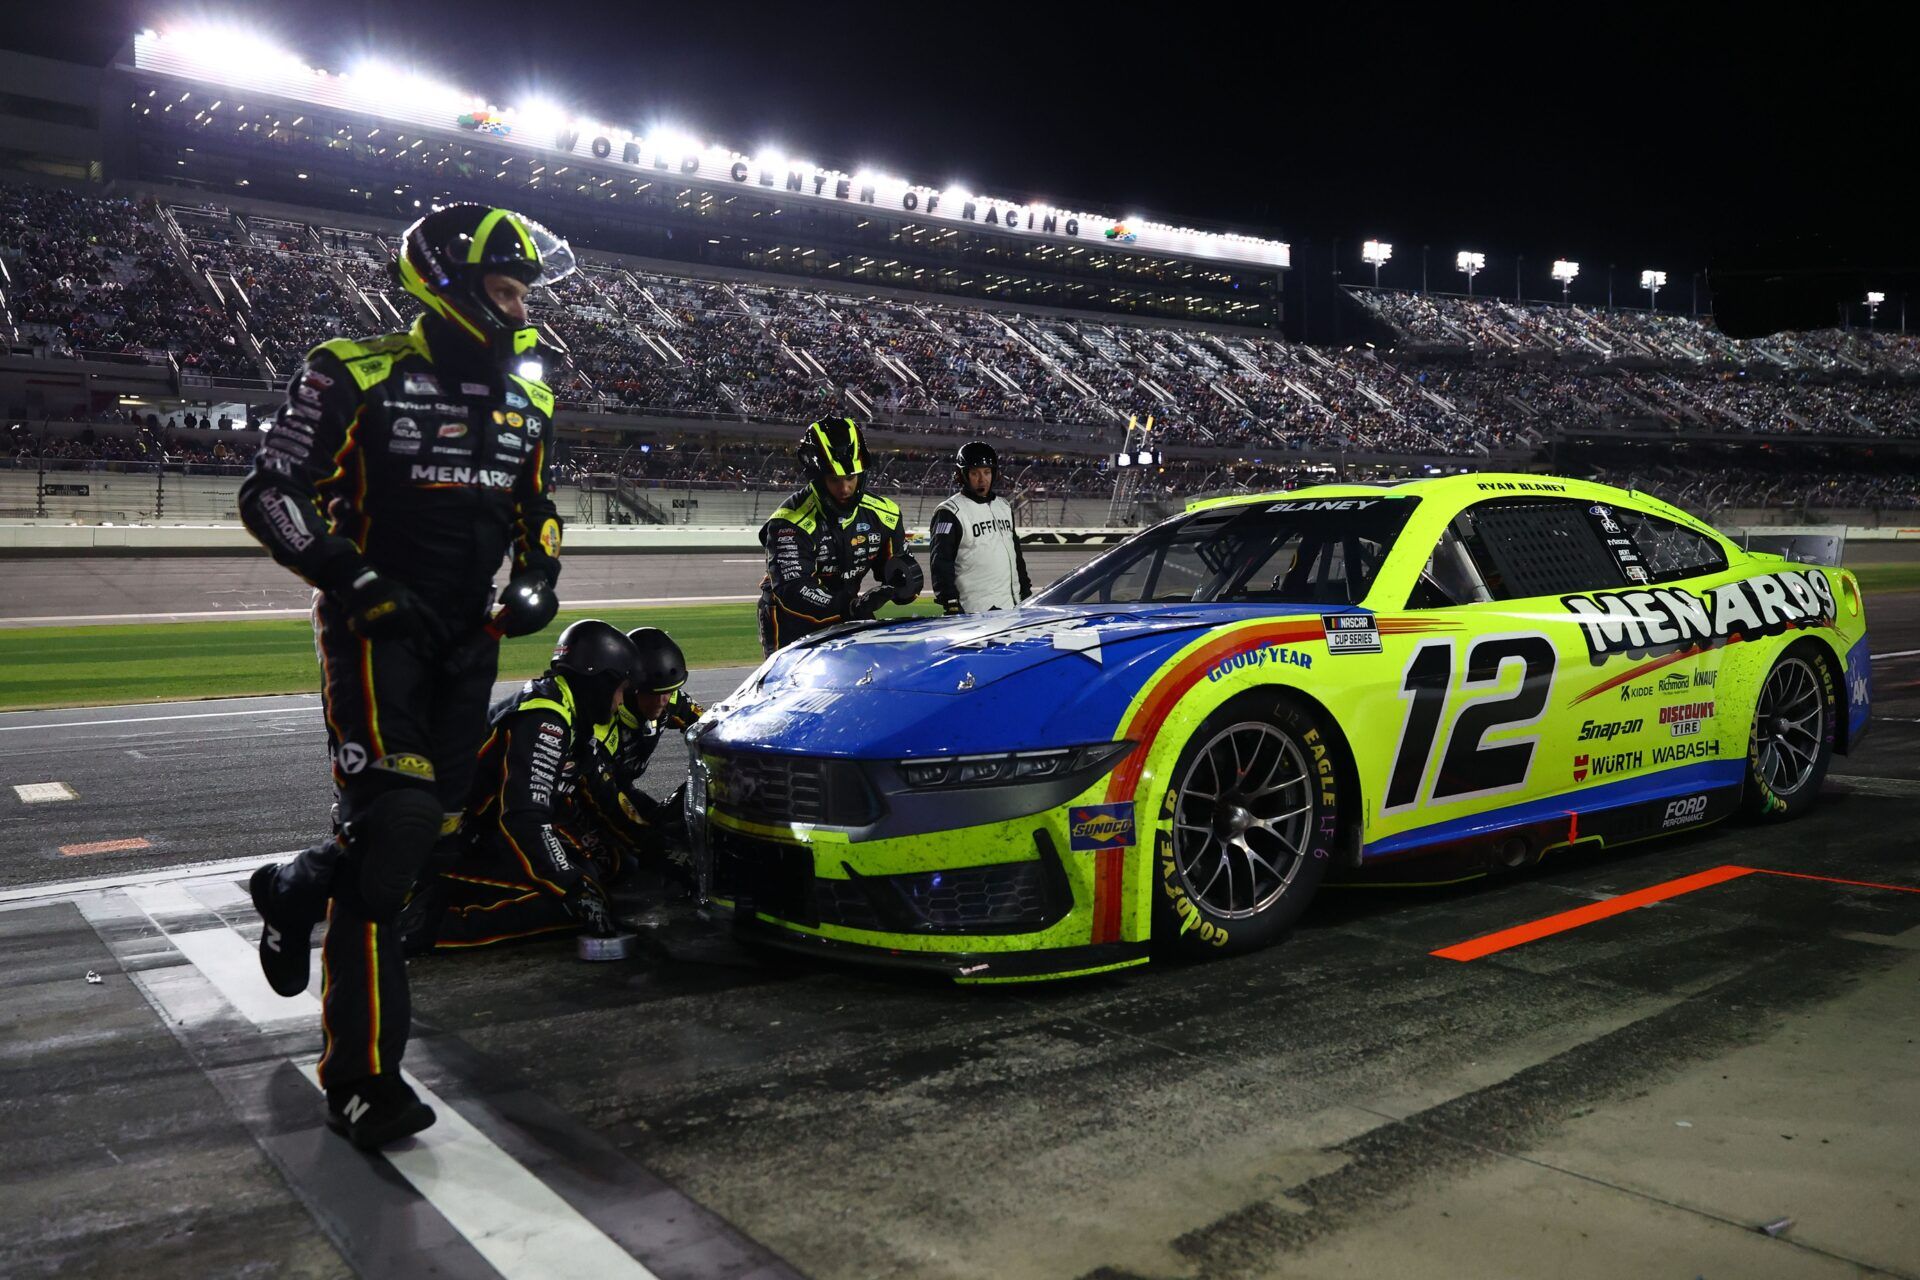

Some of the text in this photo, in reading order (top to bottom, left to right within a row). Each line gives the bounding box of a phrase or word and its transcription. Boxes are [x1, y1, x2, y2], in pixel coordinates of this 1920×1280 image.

[555, 126, 1079, 237] WORLD CENTER OF RACING
[410, 464, 517, 487] MENARDS
[1476, 482, 1566, 492] RYAN BLANEY
[1264, 500, 1379, 513] BLANEY
[972, 519, 1011, 537] OFFICIA
[1567, 569, 1836, 652] MENARDS
[1341, 617, 1368, 629] NASCAR
[1334, 634, 1373, 645] CUP SERIES
[1207, 643, 1312, 682] GOODYEAR
[1658, 675, 1690, 691] Richmond
[1693, 667, 1718, 688] KNAUF
[1814, 654, 1836, 705] EAGLE
[1631, 686, 1654, 698] KIDDE
[1382, 634, 1557, 812] 12
[1658, 701, 1715, 725] DISCOUNT
[1577, 718, 1644, 741] Snap-on
[1673, 721, 1698, 735] TIRE
[1592, 750, 1643, 775] WÜRTH
[1652, 739, 1720, 765] WABASH
[1302, 728, 1336, 808] EAGLE
[1664, 795, 1708, 819] FORD
[1073, 819, 1132, 837] SUNOCO
[1662, 811, 1705, 828] PERFORMANCE
